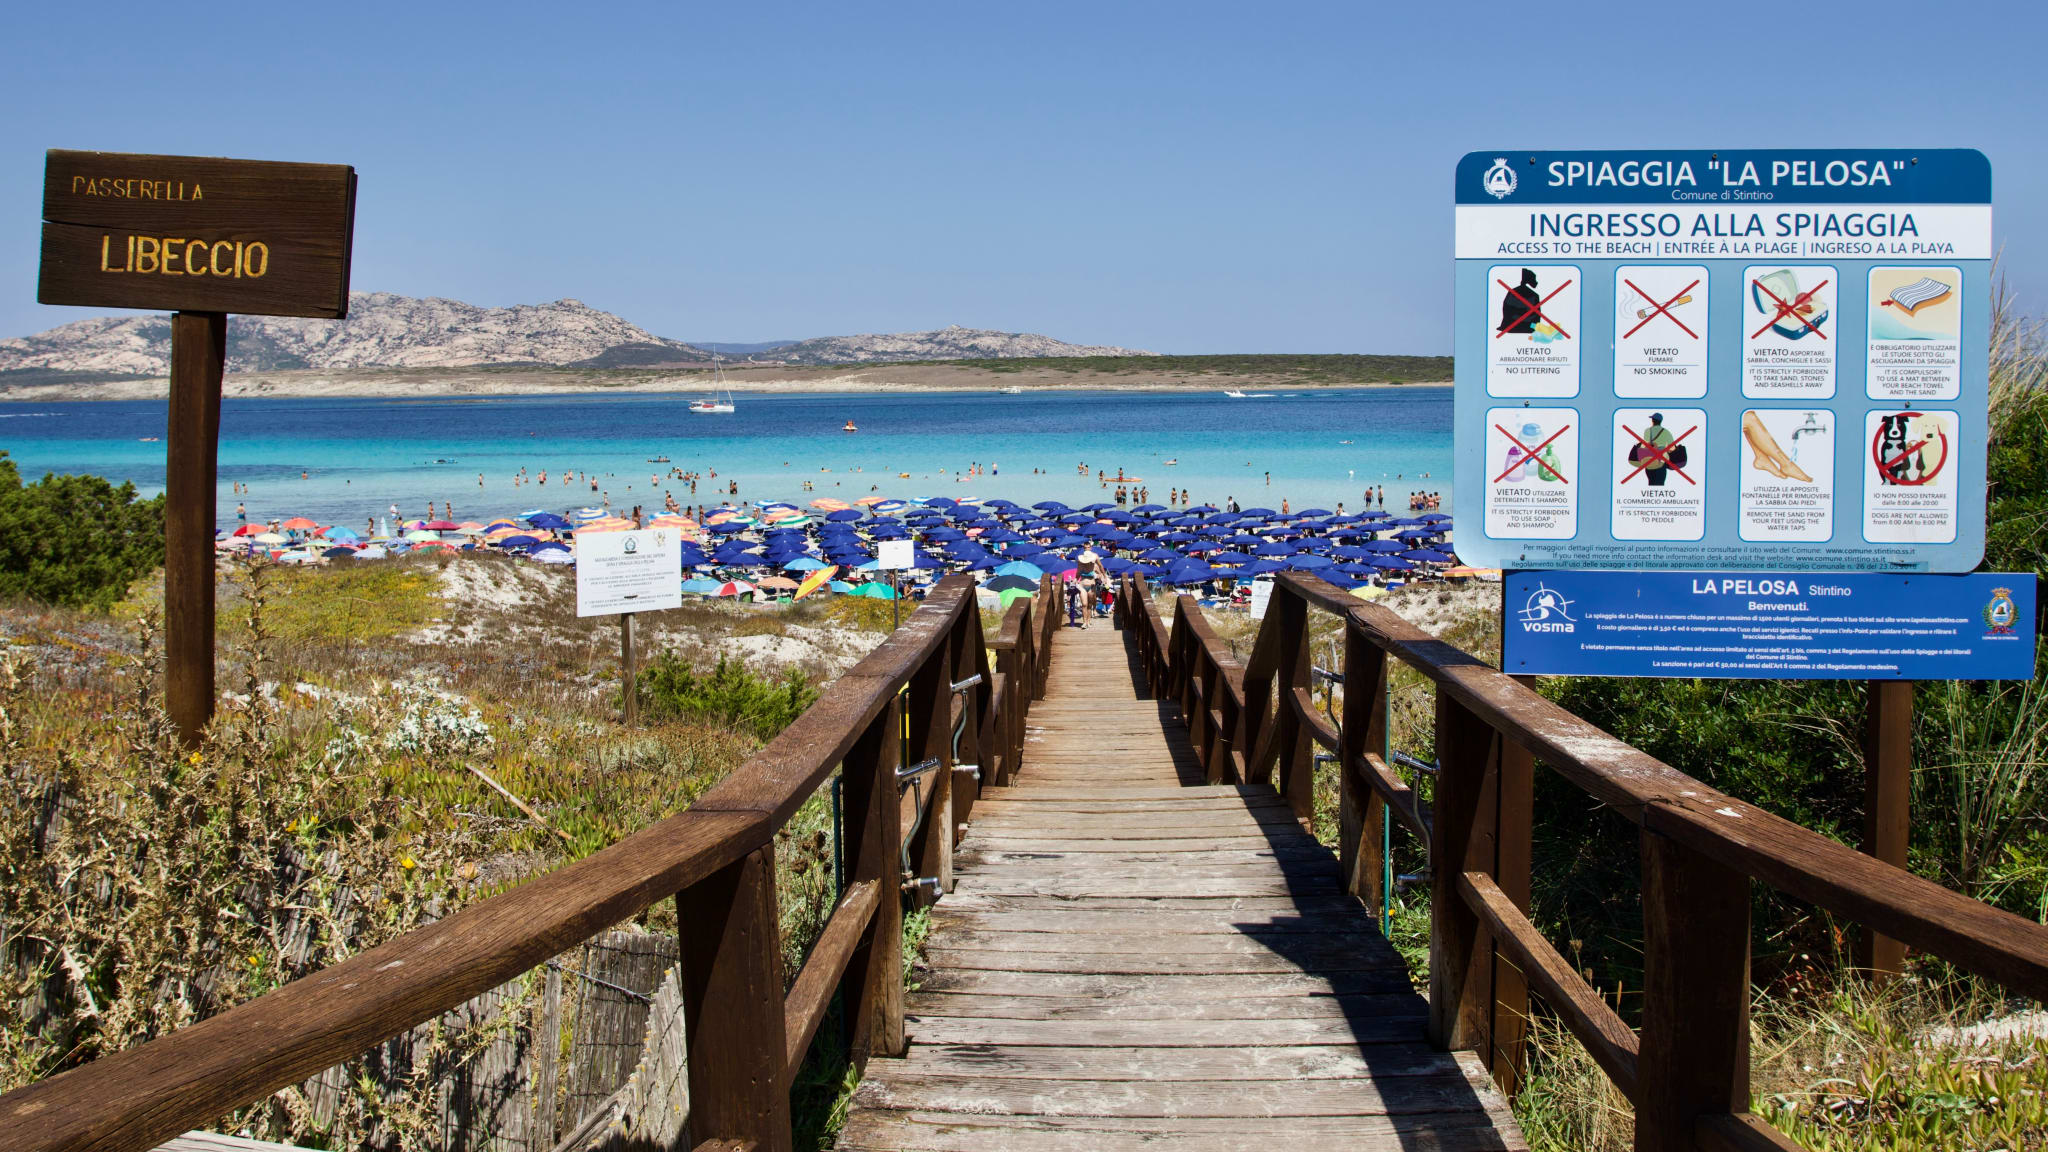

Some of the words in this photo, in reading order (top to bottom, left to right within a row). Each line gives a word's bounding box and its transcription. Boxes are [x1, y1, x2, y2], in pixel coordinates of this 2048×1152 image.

[1548, 161, 1697, 186] SPIAGGIA
[1708, 161, 1760, 186] "LA
[1772, 160, 1904, 186] PELOSA"
[1672, 190, 1718, 200] Comune
[1721, 190, 1730, 200] di
[1734, 190, 1773, 200] Stintino
[1530, 214, 1681, 237] INGRESSO
[1690, 214, 1765, 236] ALLA
[1776, 213, 1919, 237] SPIAGGIA
[1498, 242, 1548, 254] ACCESS
[1553, 242, 1572, 254] TO
[1576, 242, 1601, 254] THE
[1607, 242, 1651, 254] BEACH
[1664, 240, 1715, 254] ENTRÉE
[1719, 239, 1729, 254] À
[1734, 242, 1750, 254] LA
[1755, 242, 1798, 254] PLAGE
[1811, 242, 1872, 254] INGRESO
[1876, 242, 1885, 254] A
[1891, 242, 1907, 254] LA
[1912, 242, 1954, 254] PLAYA
[101, 235, 269, 278] LIBECCIO
[1516, 347, 1551, 355] VIETATO
[1692, 579, 1717, 594] LA
[1722, 580, 1799, 595] PELOSA
[1809, 585, 1851, 597] Stintino
[1748, 601, 1809, 611] Benvenuti.
